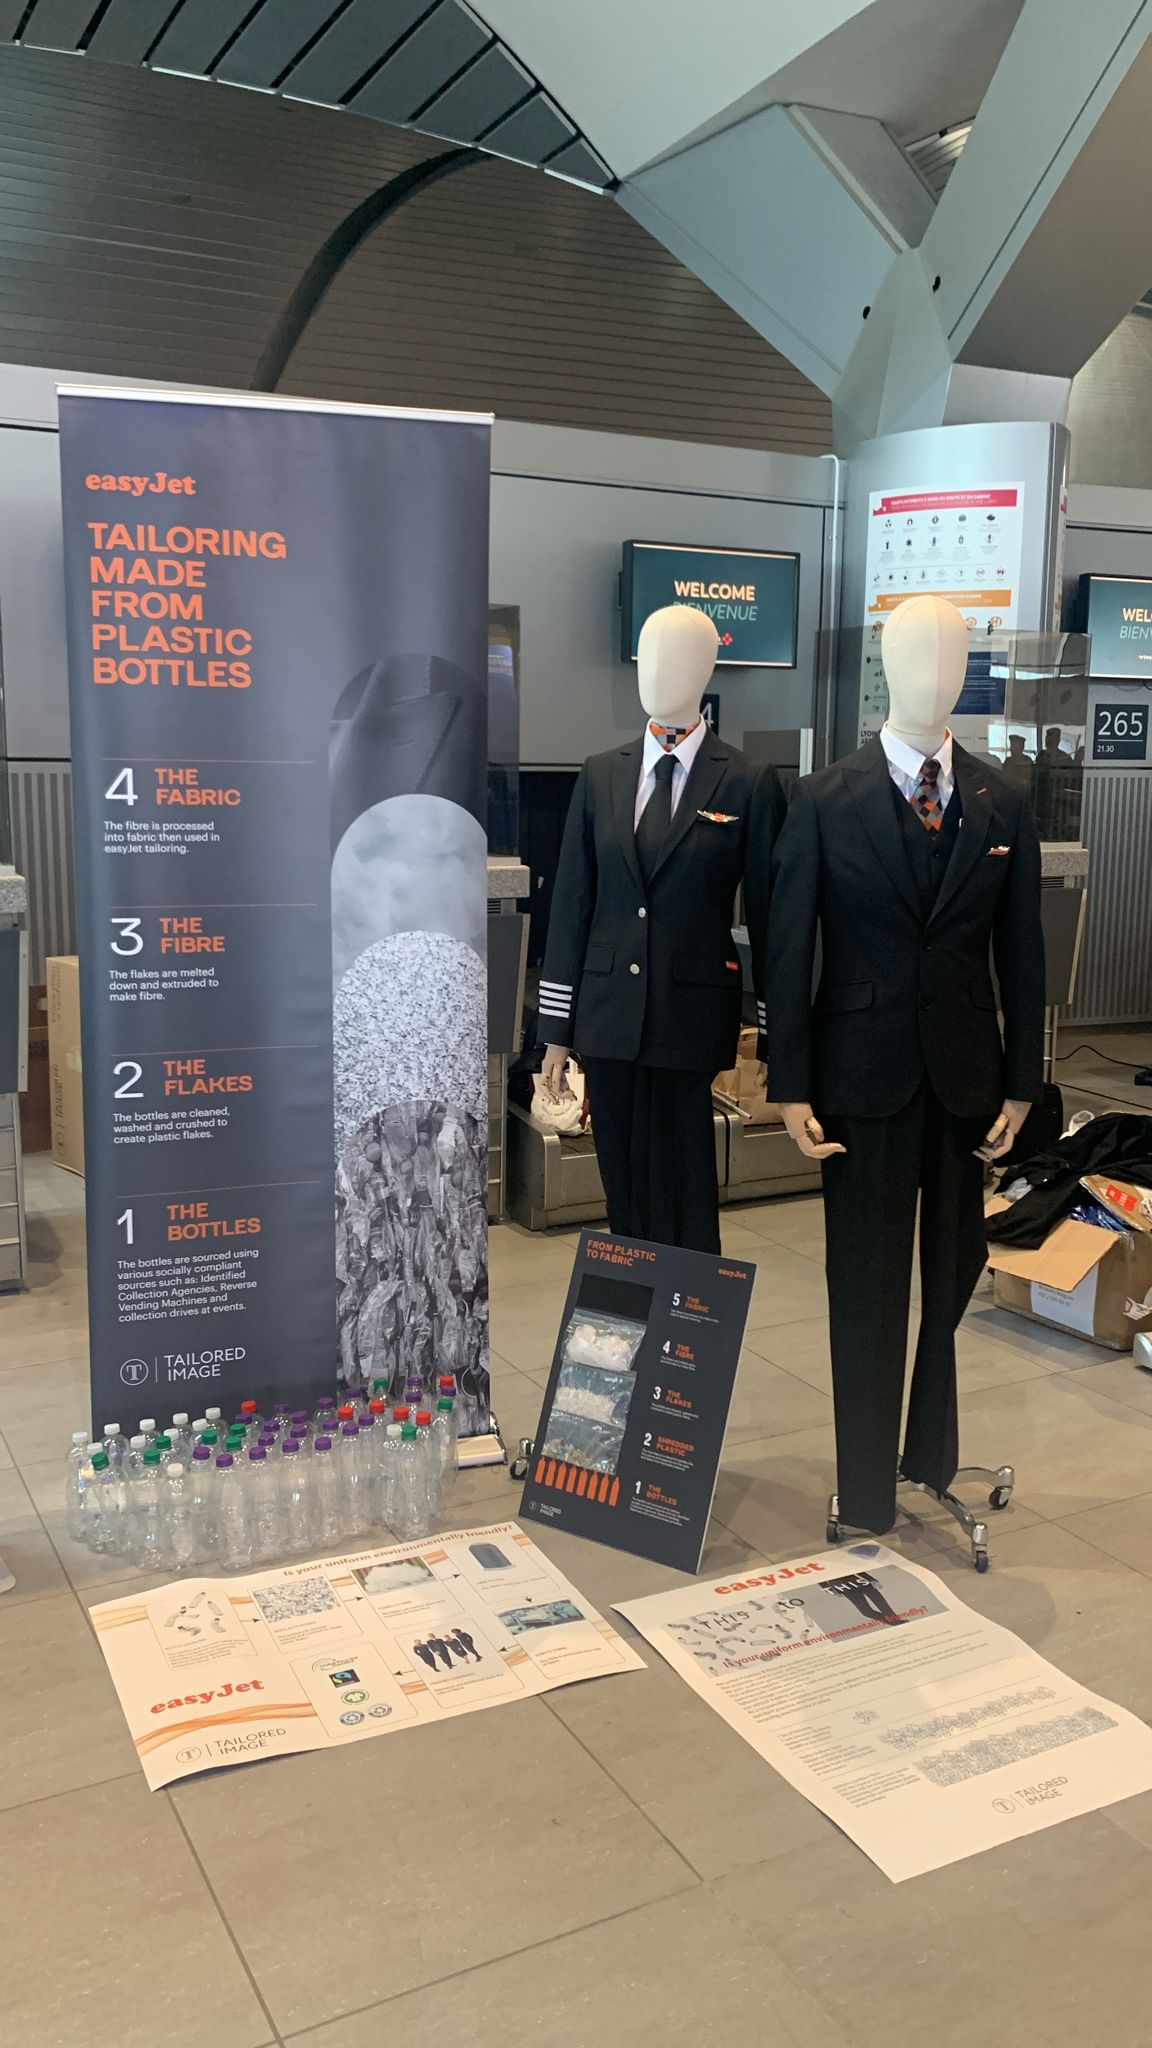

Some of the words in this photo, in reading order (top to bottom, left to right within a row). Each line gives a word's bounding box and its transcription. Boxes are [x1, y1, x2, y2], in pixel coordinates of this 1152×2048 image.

[85, 472, 196, 496] easyJet
[87, 522, 287, 559] TAILORING
[90, 556, 206, 588] MADE
[674, 580, 756, 601] WELCOME
[91, 590, 203, 621] FROM
[1122, 607, 1152, 623] WEL
[92, 624, 252, 656] PLASTIC
[93, 657, 252, 688] BOTTLES
[1097, 711, 1143, 736] 265
[1097, 745, 1114, 753] 21.30
[155, 768, 198, 785] THE
[104, 768, 138, 806] 4
[156, 788, 241, 806] FABRIC
[104, 821, 123, 830] The
[126, 821, 149, 830] fibre
[152, 821, 160, 830] is
[162, 821, 214, 832] processed
[104, 832, 124, 842] into
[127, 832, 156, 842] fabric
[159, 832, 182, 842] then
[184, 832, 208, 842] used
[211, 832, 220, 842] in
[104, 844, 142, 854] easyJet
[145, 844, 190, 854] tailoring.
[159, 917, 203, 934] THE
[110, 917, 144, 956] 3
[160, 936, 226, 954] FIBRE
[108, 970, 128, 980] The
[130, 969, 160, 979] flakes
[162, 970, 178, 978] are
[180, 966, 215, 977] melted
[110, 982, 138, 990] down
[140, 980, 160, 990] and
[162, 978, 206, 989] extruded
[208, 979, 220, 987] to
[110, 992, 137, 1002] make
[140, 991, 166, 1001] fibre.
[163, 1059, 206, 1077] THE
[113, 1061, 144, 1099] 2
[164, 1075, 254, 1096] FLAKES
[112, 1113, 132, 1122] The
[134, 1111, 169, 1122] bottles
[171, 1111, 187, 1119] are
[189, 1106, 230, 1118] cleaned,
[114, 1122, 152, 1133] washed
[154, 1120, 174, 1131] and
[176, 1118, 215, 1130] crushed
[217, 1118, 228, 1127] to
[114, 1135, 146, 1144] create
[148, 1132, 180, 1144] plastic
[183, 1130, 214, 1140] flakes.
[166, 1202, 209, 1221] THE
[116, 1208, 134, 1245] 1
[167, 1217, 262, 1241] BOTTLES
[117, 1260, 136, 1269] The
[138, 1258, 173, 1268] bottles
[174, 1256, 190, 1265] are
[192, 1250, 231, 1263] sourced
[233, 1249, 259, 1258] using
[586, 1248, 599, 1259] TO
[599, 1251, 634, 1267] FABRIC
[587, 1239, 613, 1252] FROM
[614, 1245, 656, 1262] PLASTIC
[117, 1269, 154, 1280] various
[156, 1265, 192, 1276] socially
[194, 1261, 242, 1273] compliant
[718, 1268, 748, 1280] easyJet
[118, 1281, 156, 1290] sources
[158, 1277, 182, 1287] such
[184, 1277, 198, 1285] as:
[200, 1270, 246, 1283] Identified
[118, 1290, 168, 1301] Collection
[220, 1280, 258, 1292] Reverse
[672, 1292, 680, 1306] 5
[118, 1301, 159, 1312] Vending
[162, 1296, 208, 1308] Machines
[210, 1292, 228, 1303] and
[684, 1301, 710, 1312] FABRIC
[687, 1296, 700, 1304] THE
[118, 1310, 168, 1322] collection
[170, 1307, 199, 1318] drives
[201, 1305, 210, 1314] at
[212, 1302, 247, 1313] events.
[662, 1340, 671, 1354] 4
[164, 1347, 246, 1368] TAILORED
[167, 1364, 222, 1382] IMAGE
[652, 1386, 662, 1400] 3
[666, 1396, 692, 1408] FLAKES
[668, 1390, 681, 1398] THE
[643, 1432, 652, 1446] 2
[657, 1436, 694, 1452] SHREDDED
[656, 1443, 686, 1457] PLASTIC
[635, 1480, 642, 1494] 1
[648, 1484, 662, 1494] THE
[646, 1491, 678, 1506] BOTTLES
[296, 1562, 323, 1576] your
[324, 1555, 372, 1568] uniform
[374, 1532, 464, 1558] environmentally
[465, 1524, 513, 1538] friendly?
[714, 1561, 825, 1595] easyJet
[823, 1577, 868, 1596] THIS
[699, 1610, 750, 1630] THIS
[735, 1653, 760, 1666] your
[761, 1642, 804, 1658] uniform
[804, 1616, 886, 1647] environmentally
[150, 1679, 265, 1714] easyJet
[214, 1728, 286, 1748] TAILORED
[220, 1739, 269, 1756] IMAGE
[1014, 1776, 1068, 1798] TAILORED
[1024, 1788, 1063, 1806] IMAGE
